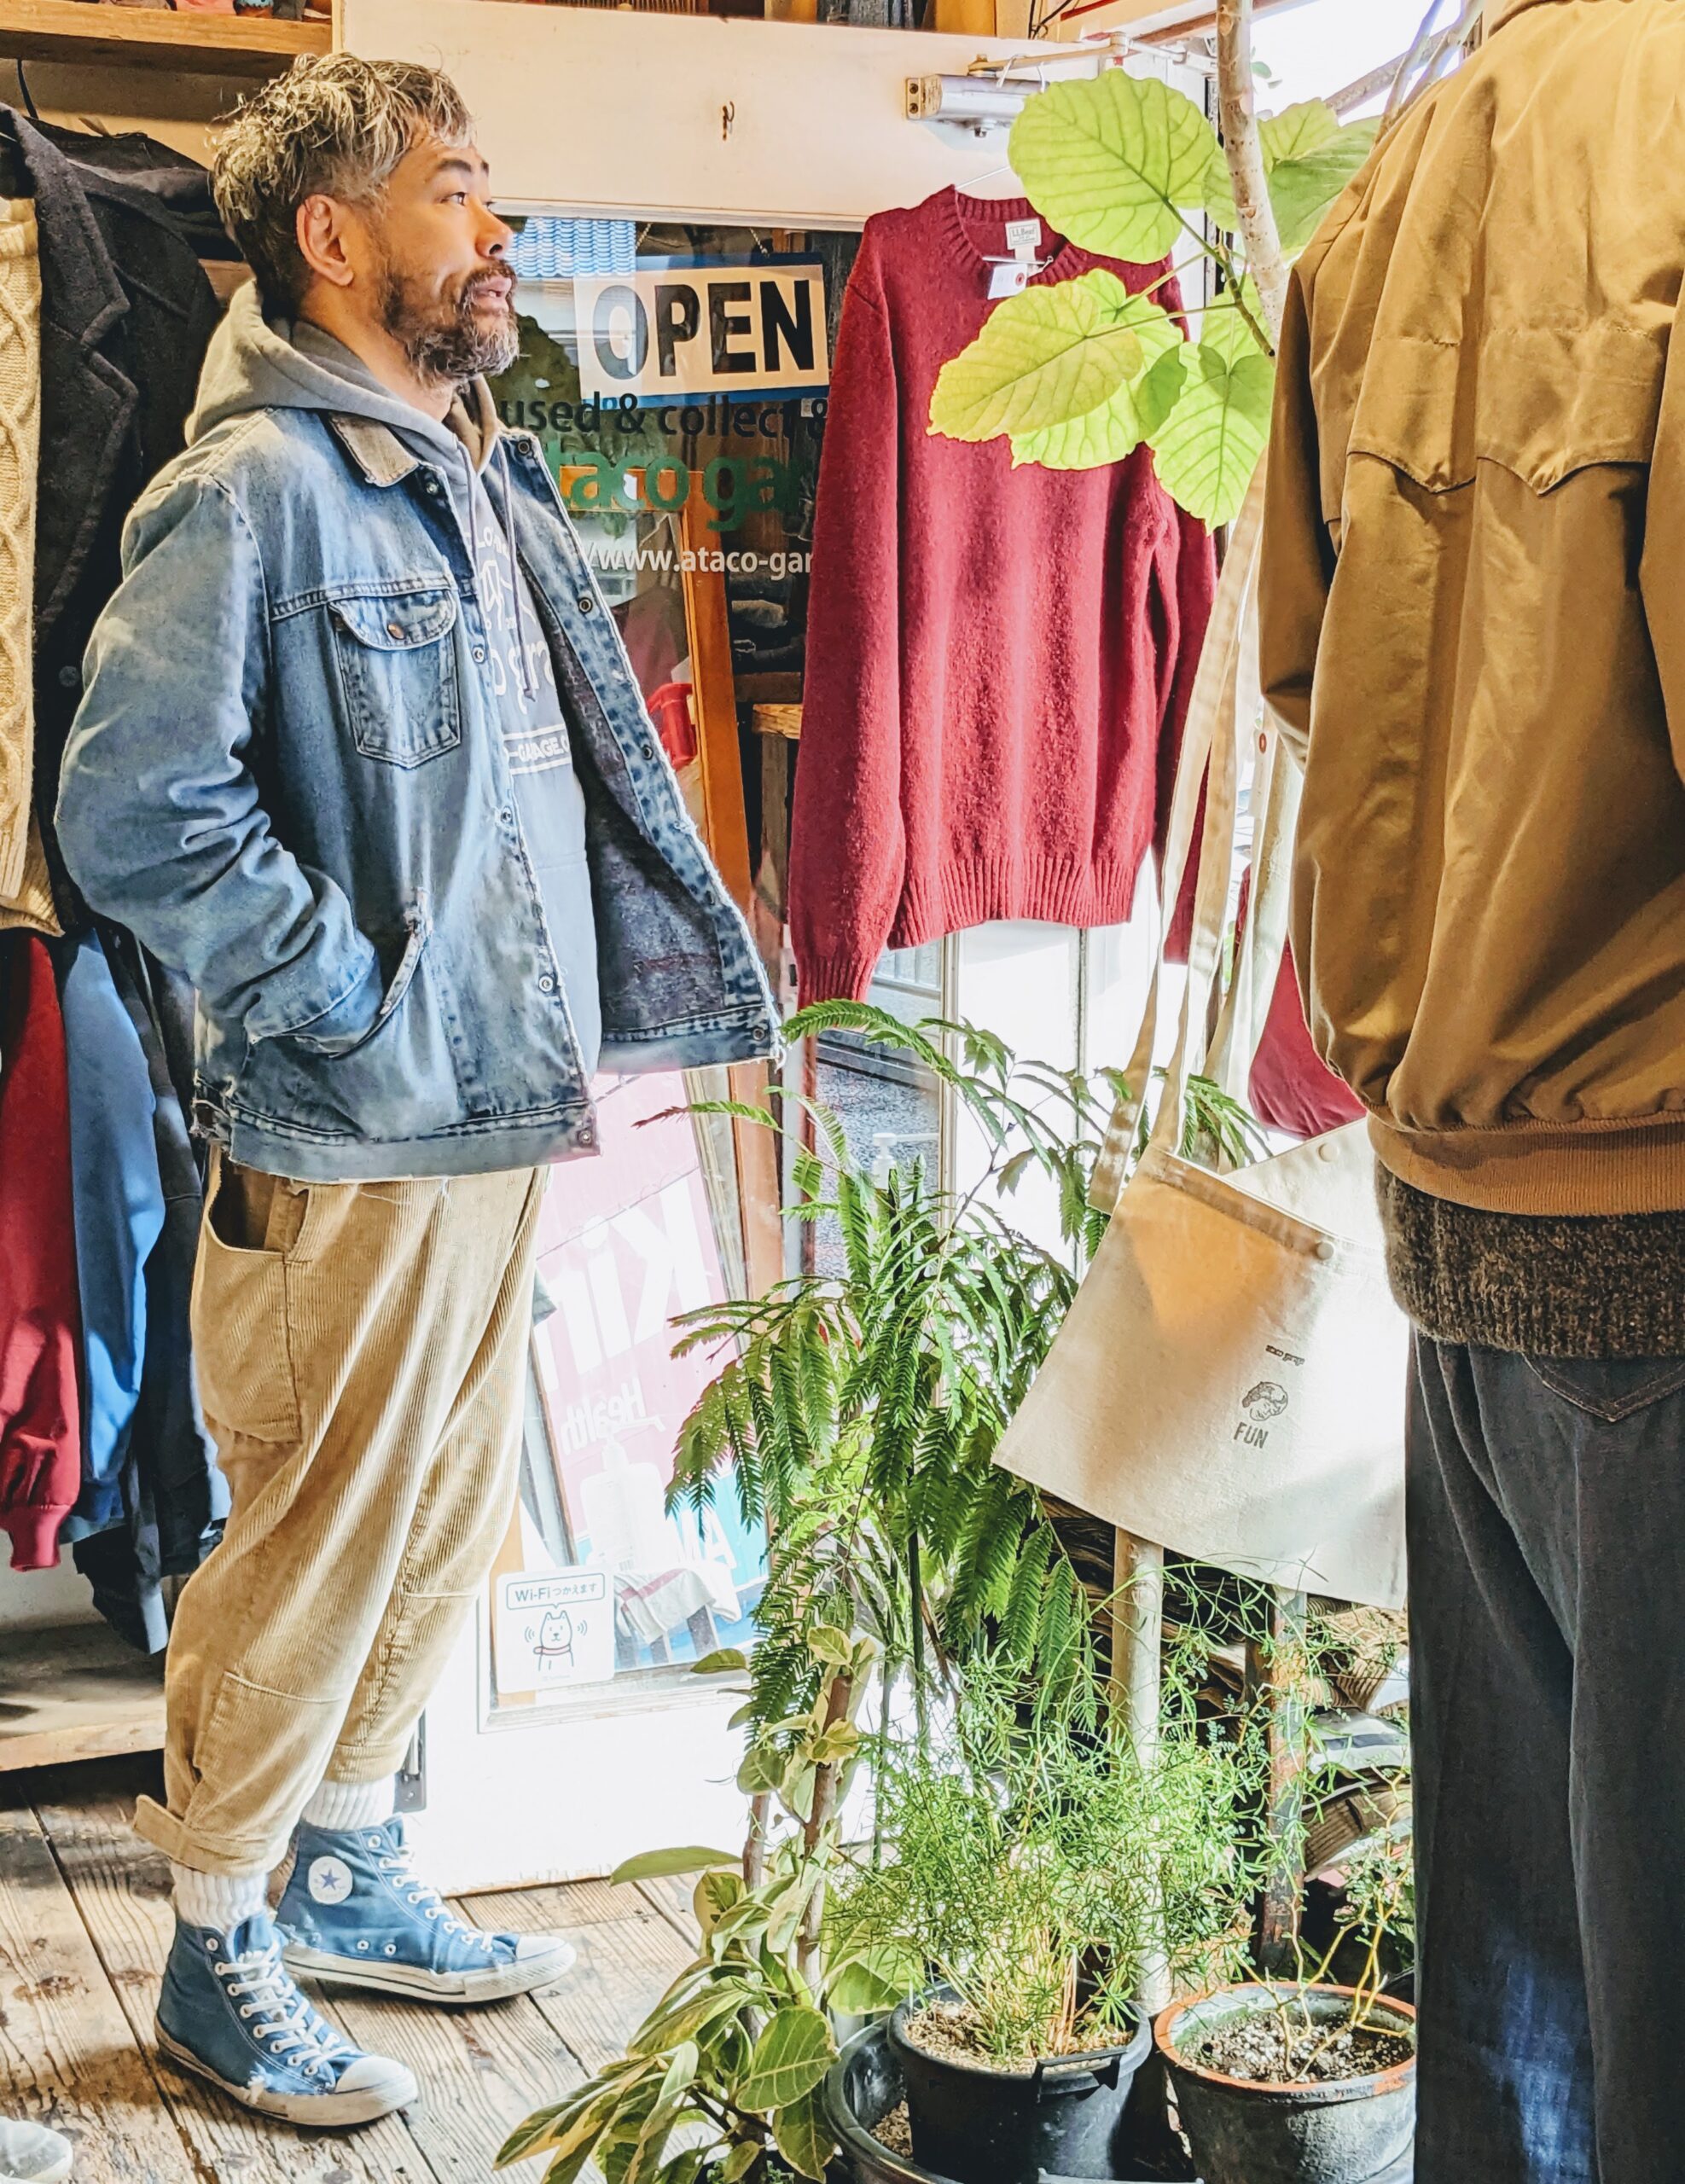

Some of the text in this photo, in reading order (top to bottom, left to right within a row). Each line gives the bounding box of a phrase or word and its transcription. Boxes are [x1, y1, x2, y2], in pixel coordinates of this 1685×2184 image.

[592, 280, 815, 380] OPEN
[501, 391, 601, 433] used
[619, 392, 647, 434] &
[659, 394, 794, 439] collect
[542, 440, 689, 512] taco
[1234, 1421, 1269, 1449] FUN
